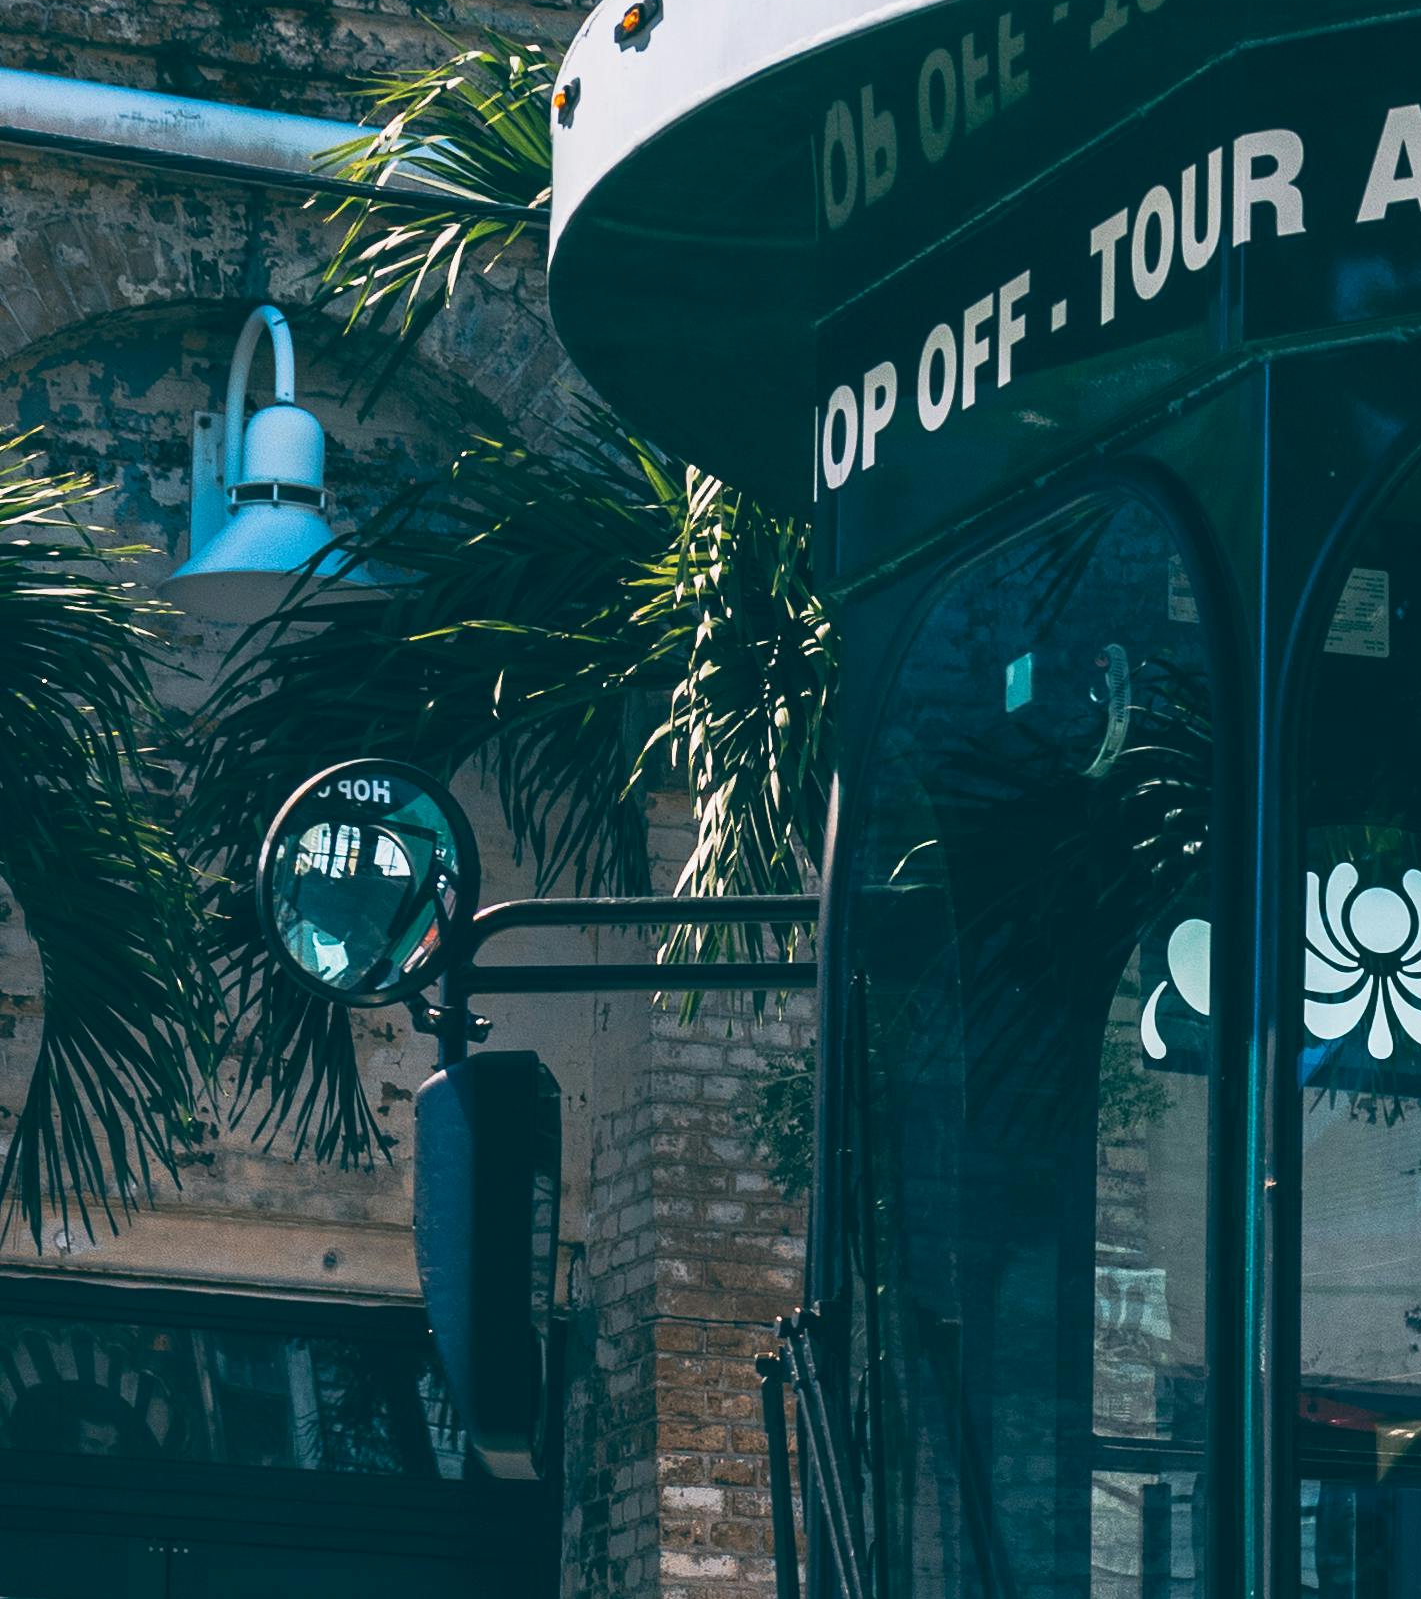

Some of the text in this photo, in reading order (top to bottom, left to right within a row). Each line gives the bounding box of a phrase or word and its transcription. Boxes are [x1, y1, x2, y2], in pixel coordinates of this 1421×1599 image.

[812, 359, 897, 503] OP
[917, 269, 1032, 434] OFF
[1090, 128, 1306, 327] TOUR
